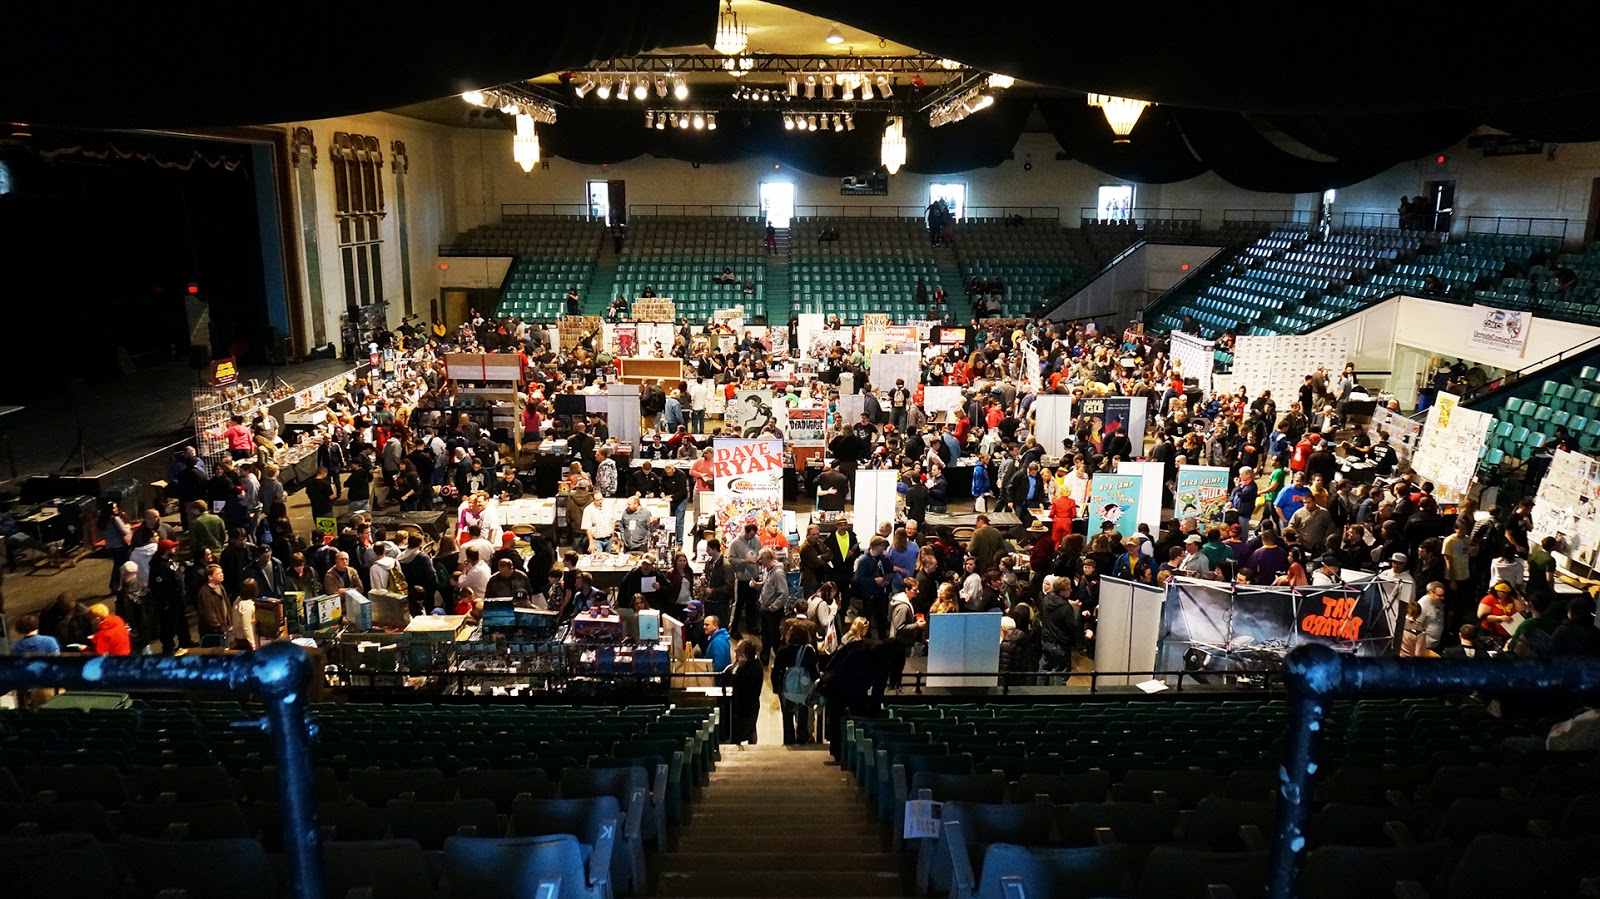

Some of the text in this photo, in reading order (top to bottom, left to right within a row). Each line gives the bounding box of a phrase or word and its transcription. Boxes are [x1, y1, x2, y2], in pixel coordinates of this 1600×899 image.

[716, 442, 771, 461] DAVE
[714, 453, 783, 478] RYAN
[1202, 487, 1226, 501] HULK
